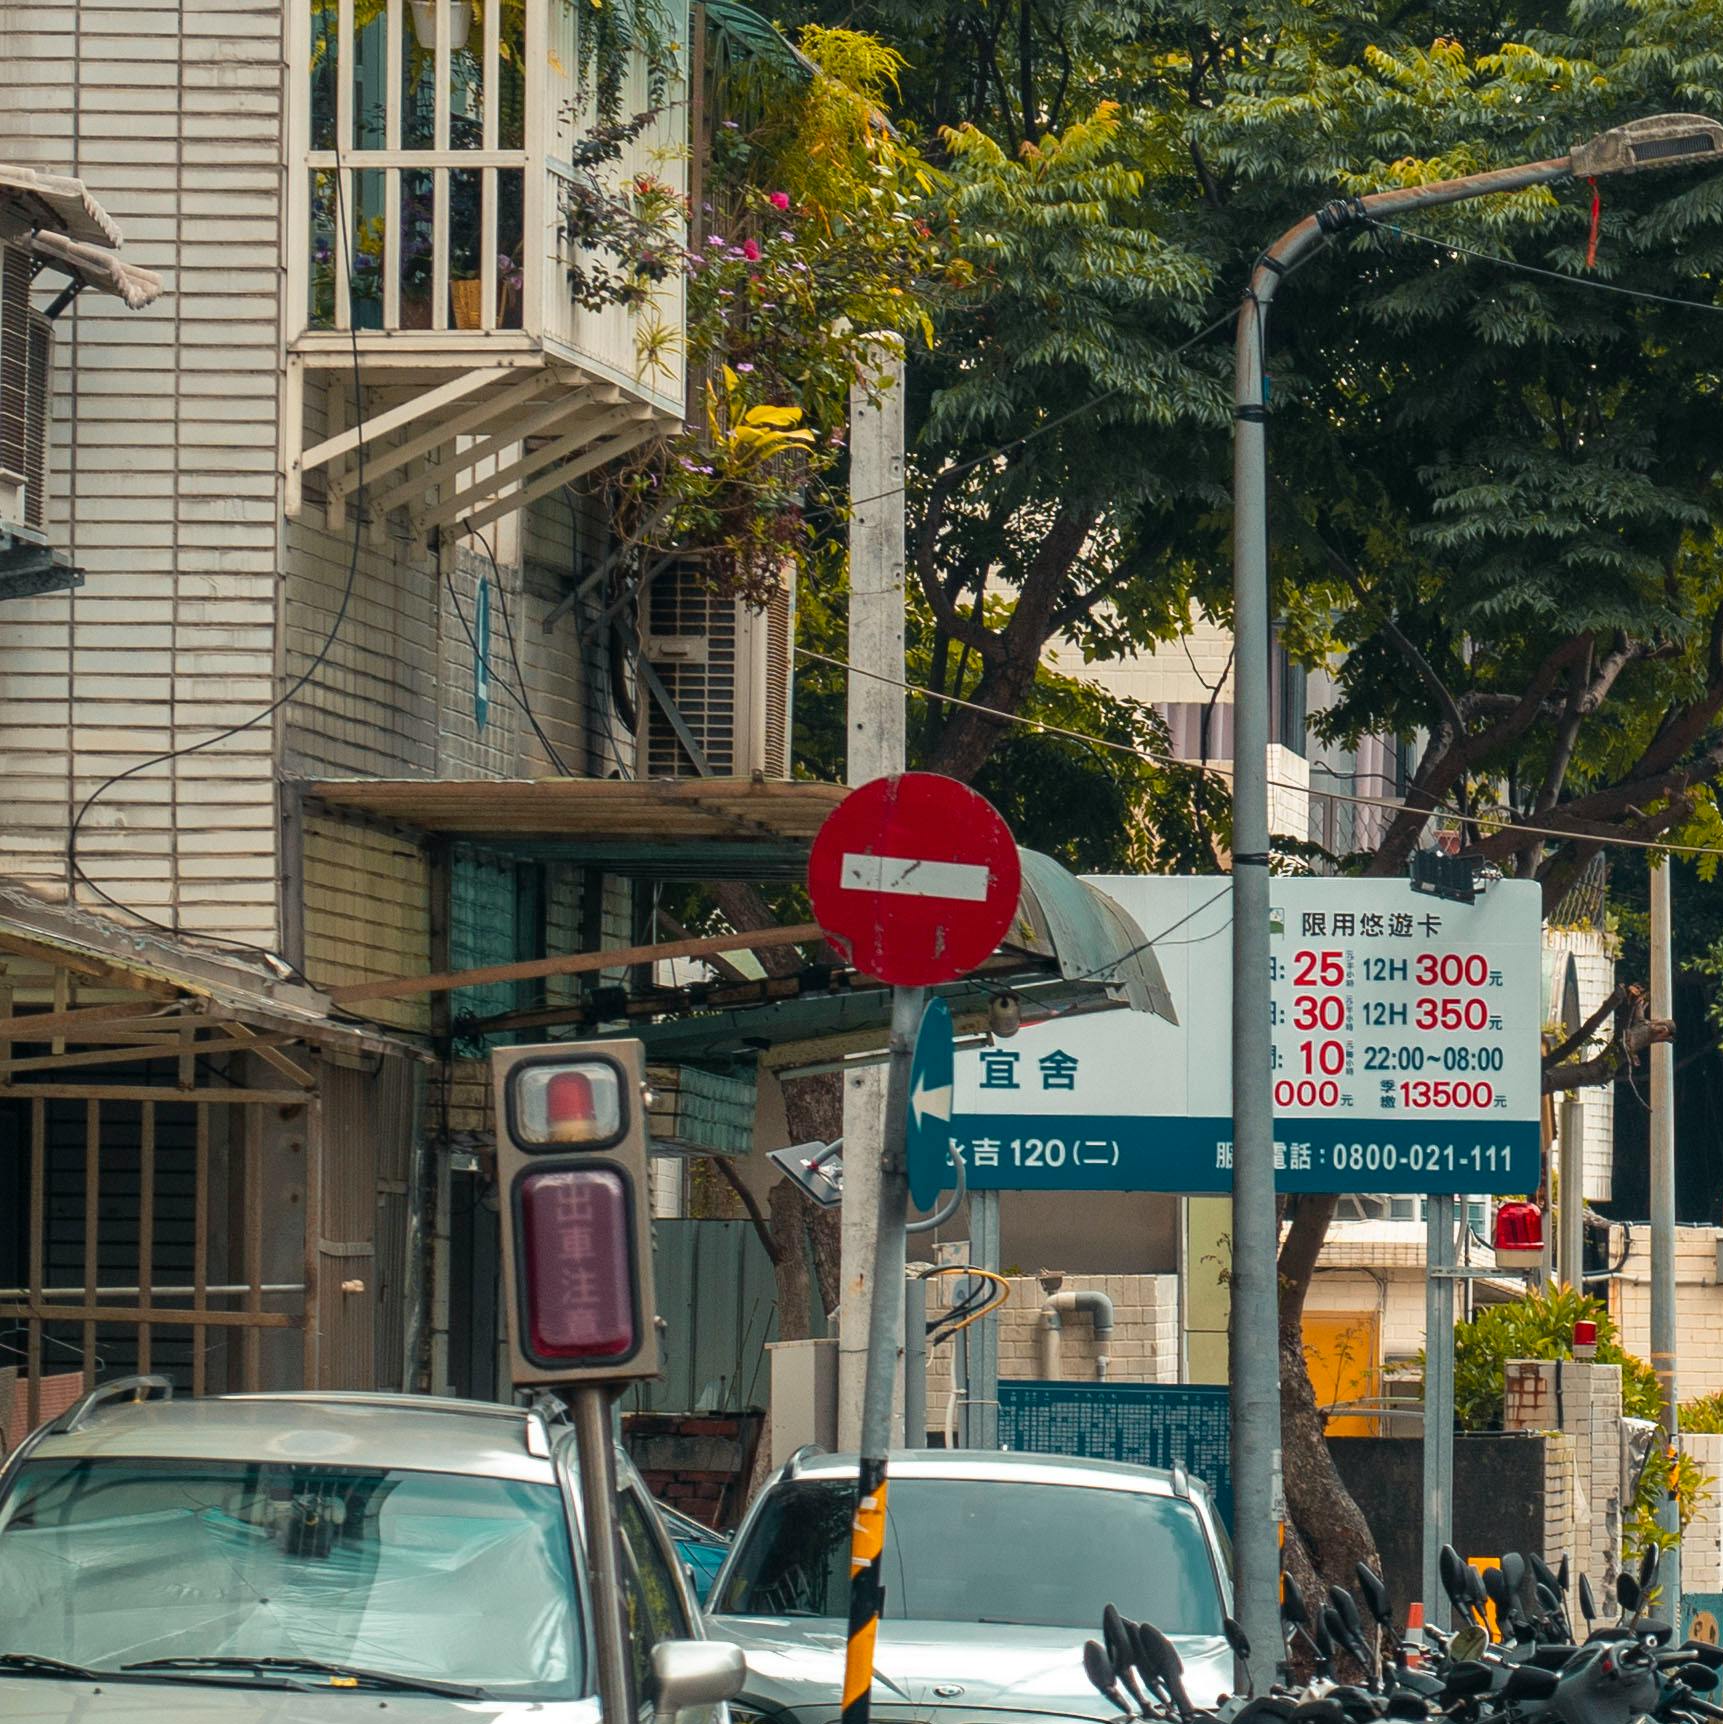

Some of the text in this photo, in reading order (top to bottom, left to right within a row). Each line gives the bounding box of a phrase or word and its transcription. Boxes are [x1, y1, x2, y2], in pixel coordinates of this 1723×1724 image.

[1302, 912, 1443, 938] 限用悠遊卡
[1293, 950, 1345, 986] 25
[1363, 957, 1408, 981] 12H
[1293, 995, 1345, 1031] 30
[1363, 1002, 1408, 1026] 12H
[979, 1049, 1079, 1090] 宜舍
[1300, 1040, 1345, 1075] 10
[1364, 1046, 1504, 1071] 22:00~08:00
